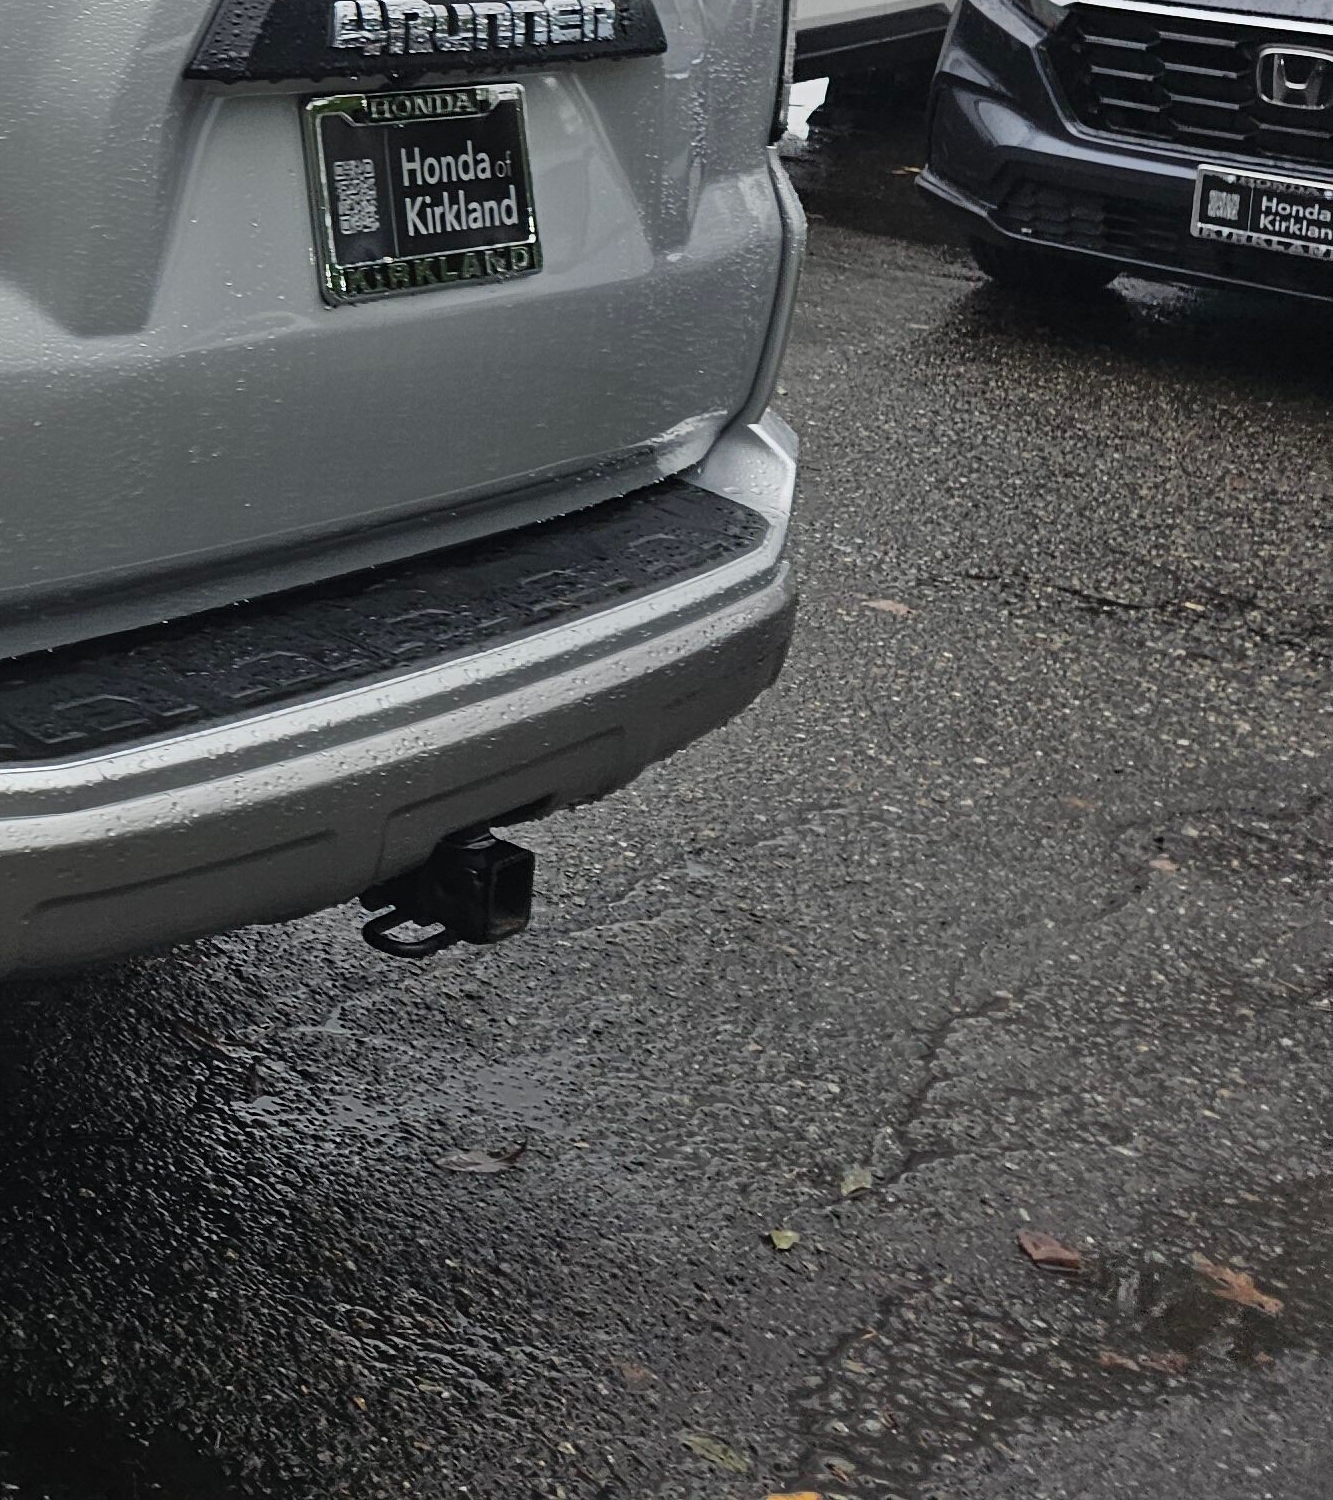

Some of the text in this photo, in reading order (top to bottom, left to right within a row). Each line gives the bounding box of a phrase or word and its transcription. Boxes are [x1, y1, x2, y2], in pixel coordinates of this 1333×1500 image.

[370, 91, 477, 119] HONDA
[400, 140, 512, 187] Honda of
[404, 184, 519, 237] Kirkland
[1261, 195, 1332, 222] Honda
